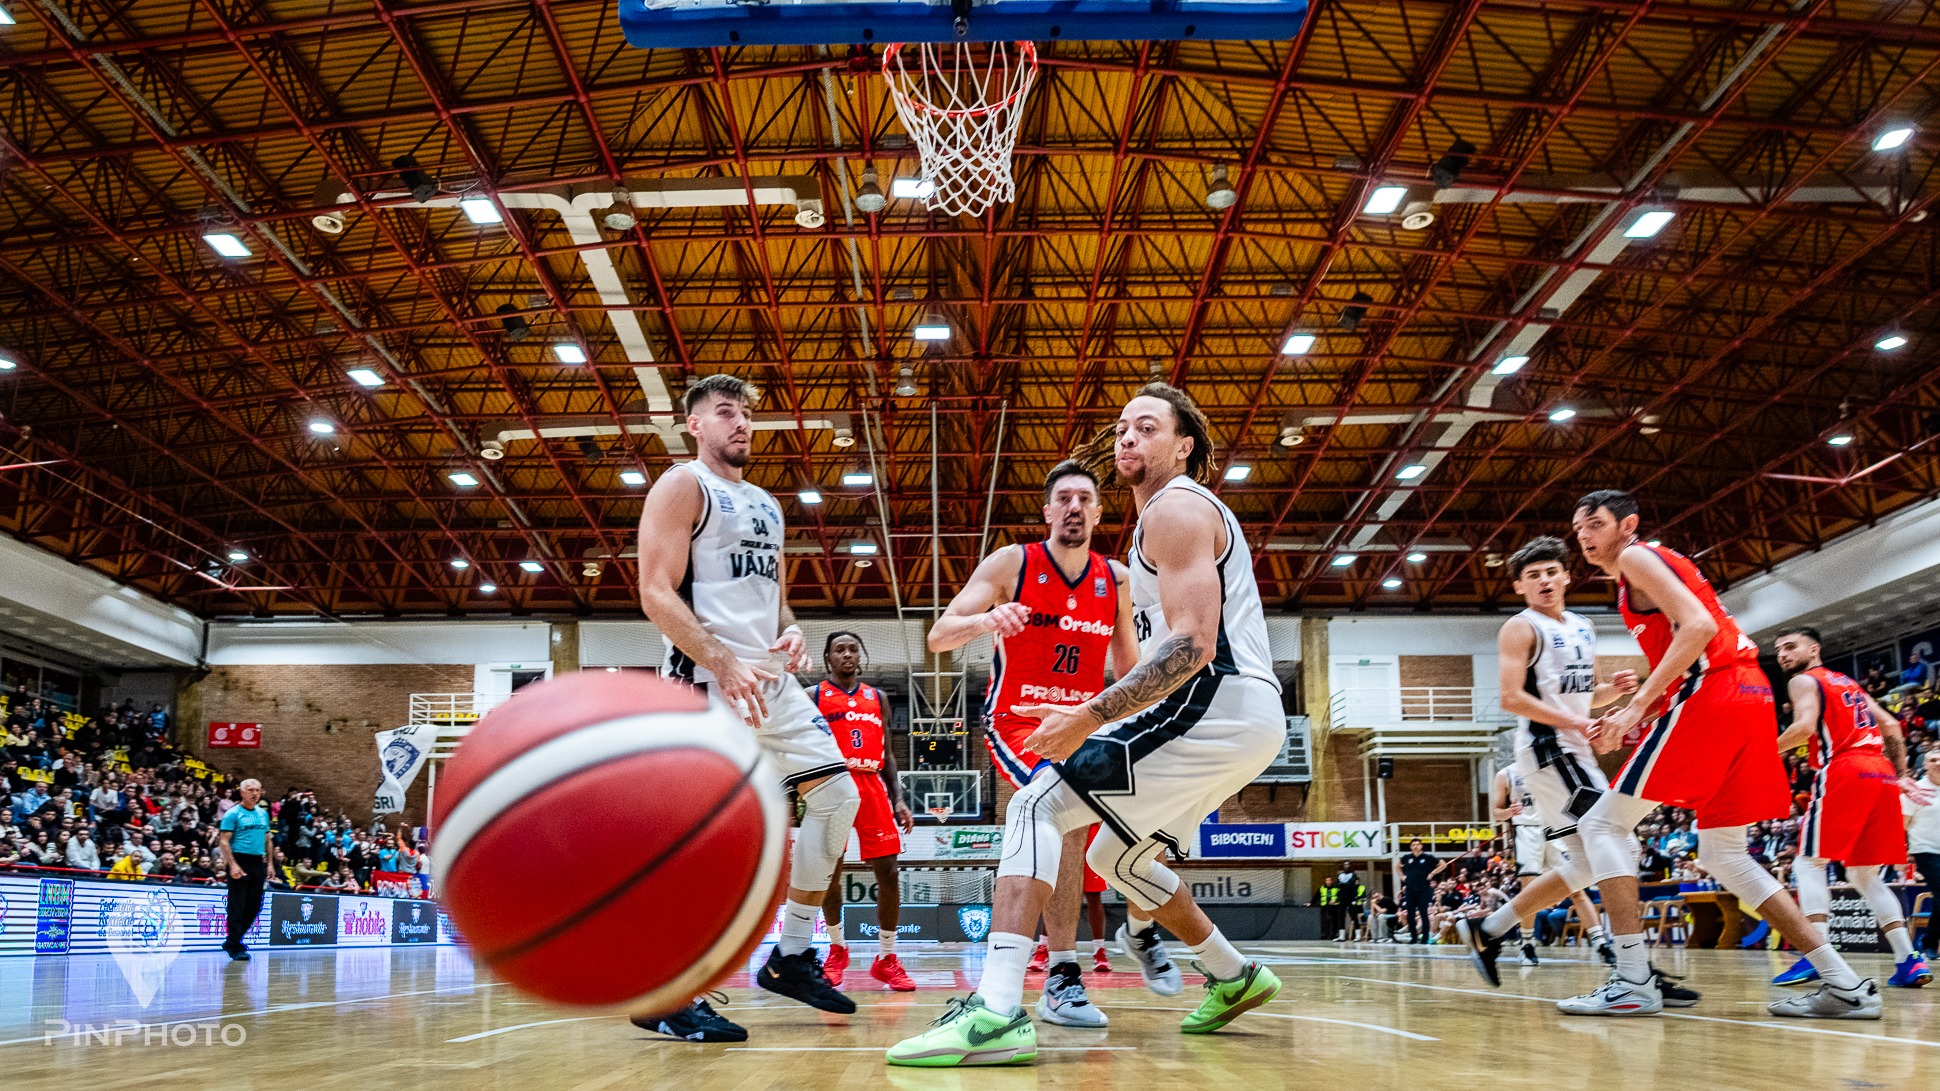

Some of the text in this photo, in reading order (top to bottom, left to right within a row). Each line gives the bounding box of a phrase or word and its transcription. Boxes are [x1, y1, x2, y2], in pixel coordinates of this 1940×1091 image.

[752, 517, 769, 536] 34
[1051, 643, 1081, 675] 26
[850, 728, 863, 749] 3
[929, 741, 937, 751] 2
[1210, 832, 1275, 847] BIBORTENI
[1291, 830, 1379, 849] STICKY
